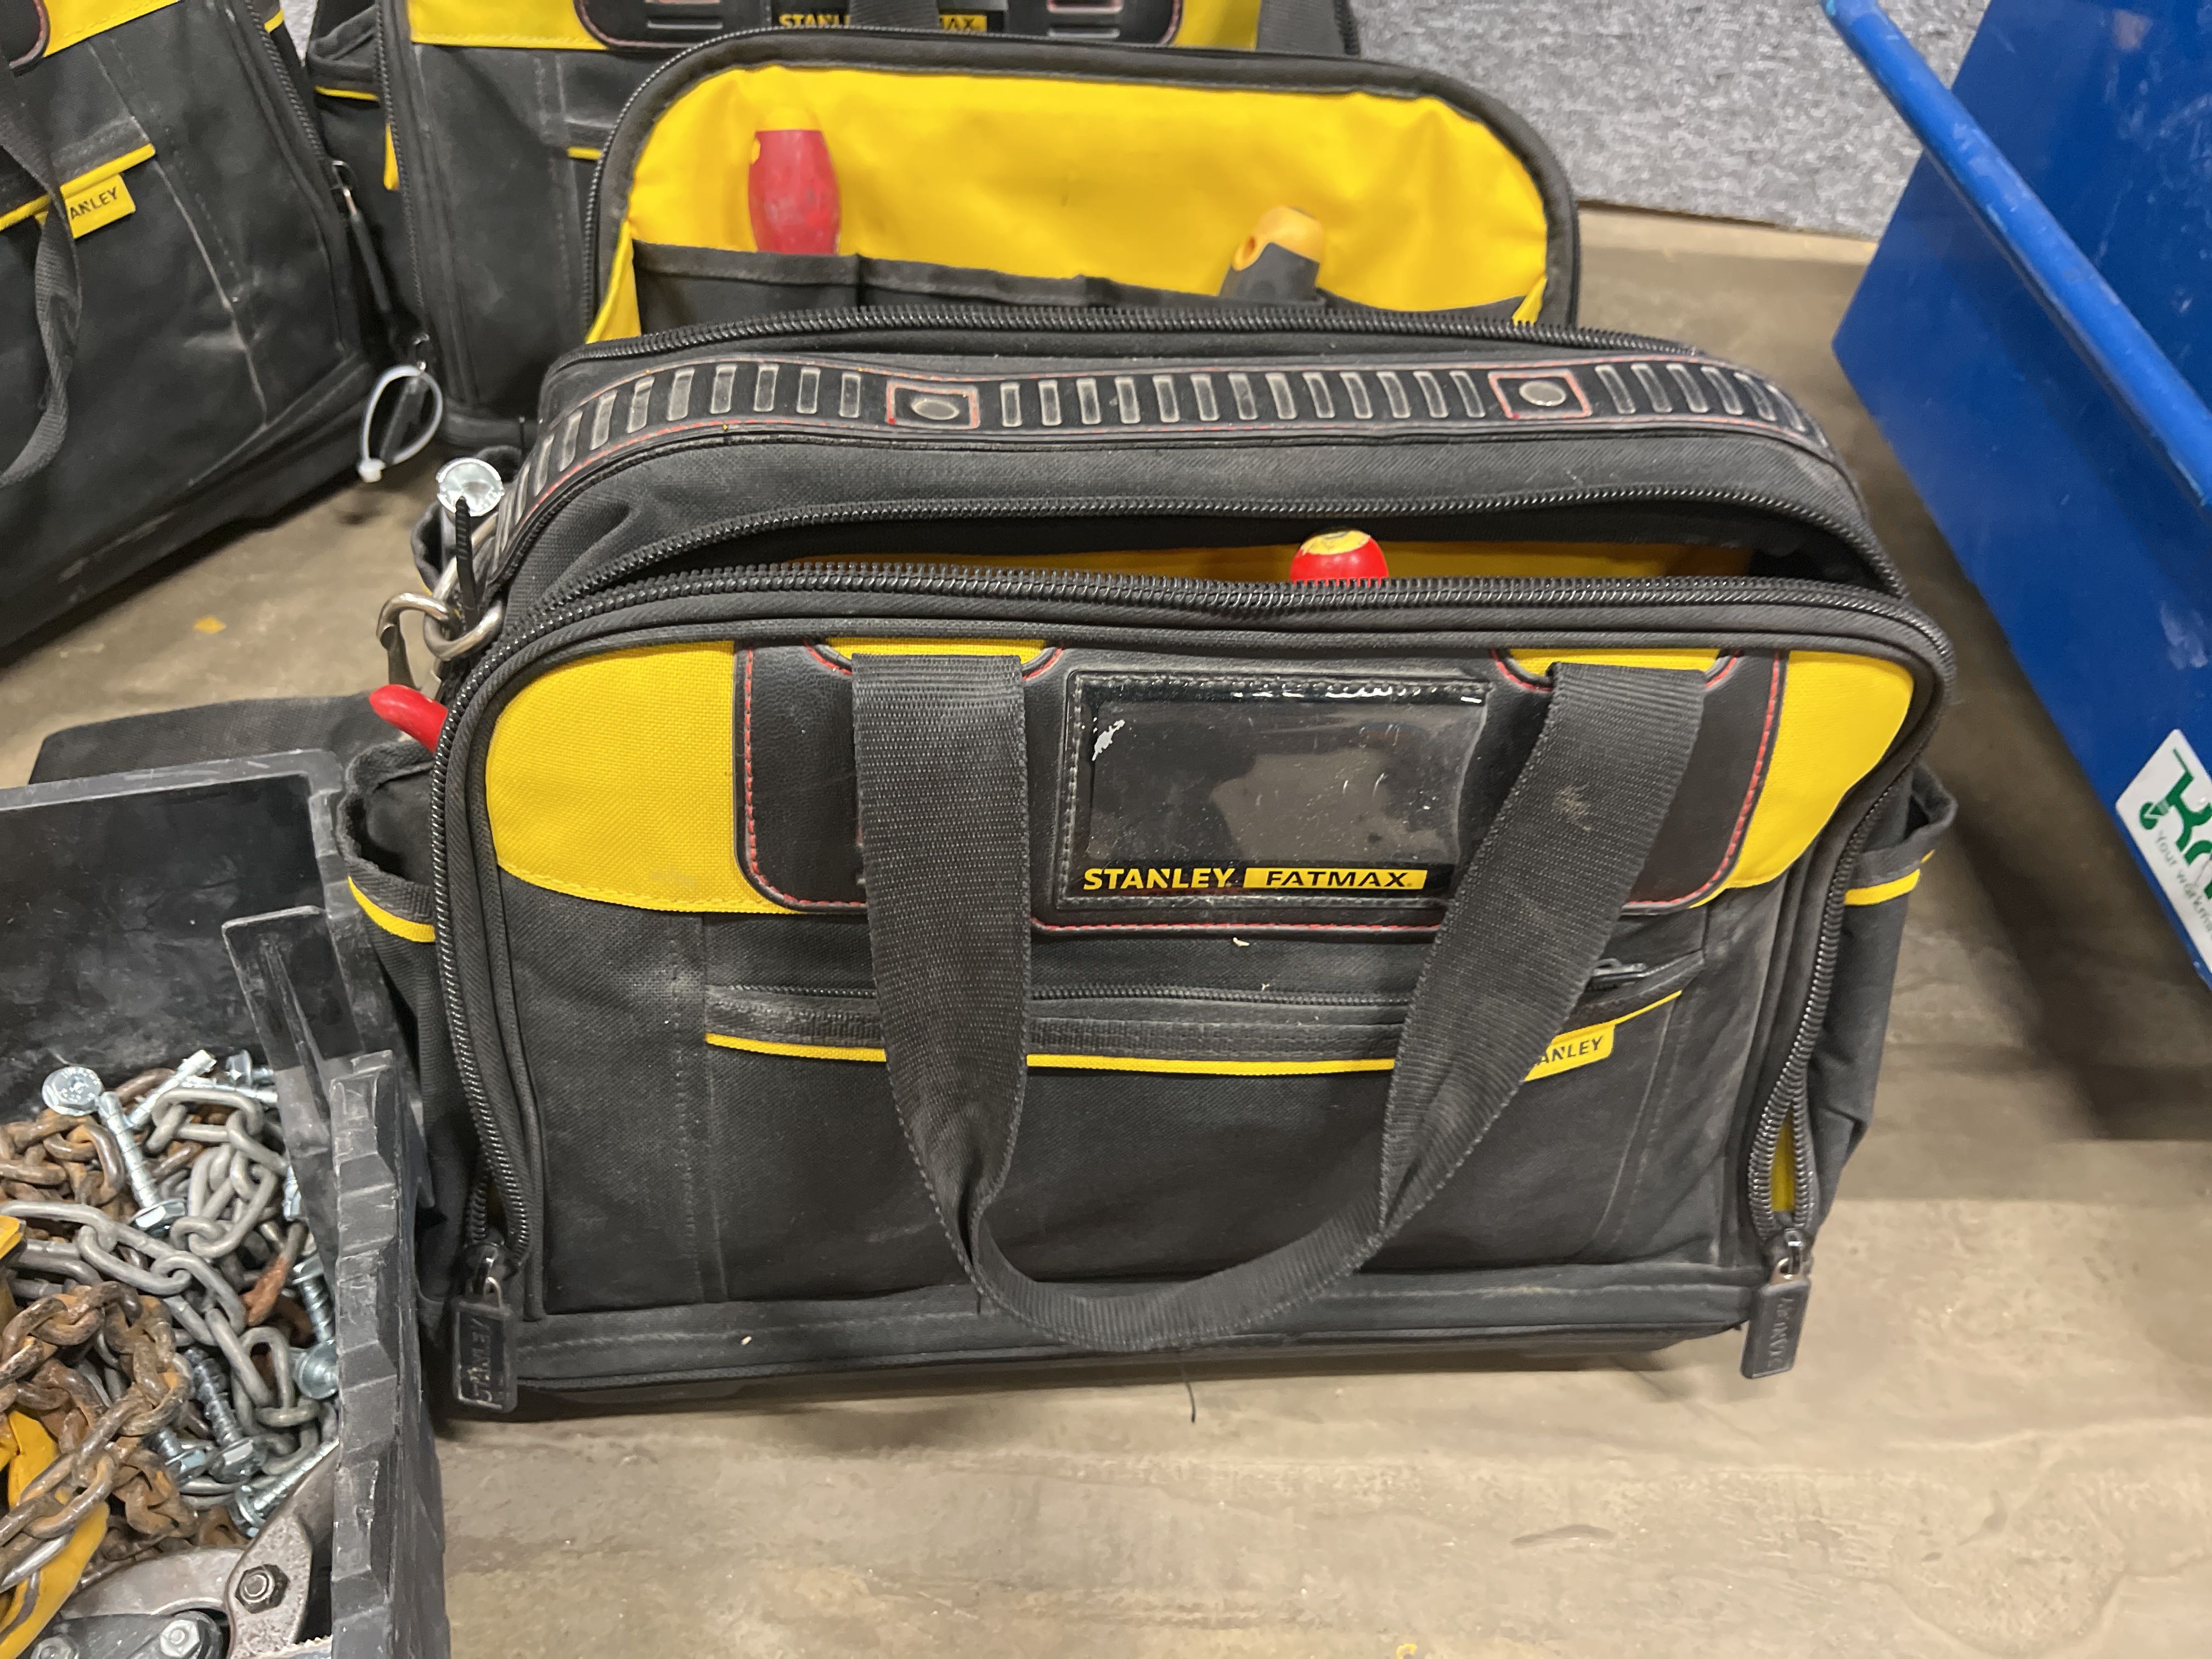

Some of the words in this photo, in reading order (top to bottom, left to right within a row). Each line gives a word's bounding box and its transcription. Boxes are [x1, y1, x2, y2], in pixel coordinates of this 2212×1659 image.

[70, 187, 117, 220] ANLEY
[1084, 868, 1235, 889] STANLEY
[1266, 871, 1408, 887] FATMAX
[1537, 1035, 1603, 1065] ANLEY
